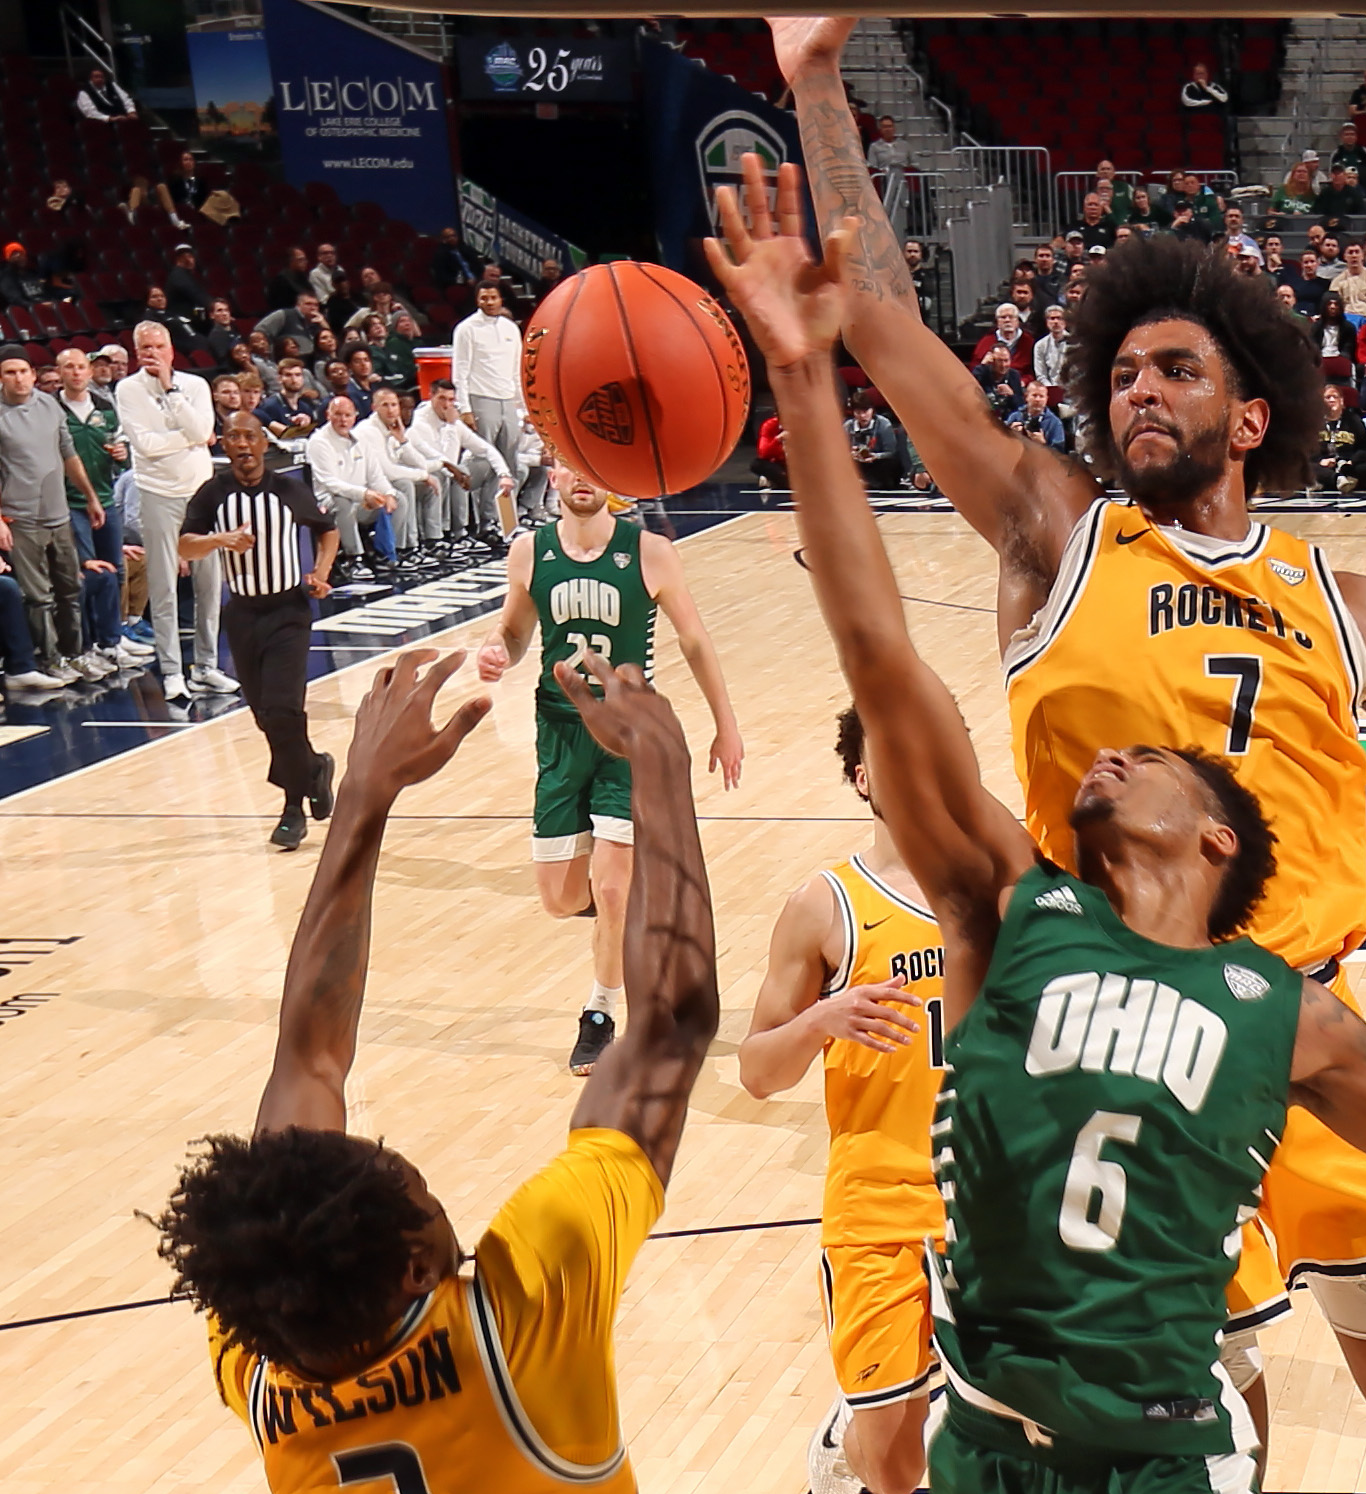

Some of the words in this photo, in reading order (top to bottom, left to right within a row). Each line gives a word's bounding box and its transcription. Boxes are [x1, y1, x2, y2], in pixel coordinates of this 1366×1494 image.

[522, 47, 571, 92] 25
[306, 128, 317, 137] OF
[319, 128, 377, 137] OSTEOPATHIC
[379, 128, 421, 137] MEDICINE
[320, 118, 343, 127] LAKE
[344, 118, 362, 127] ERIE
[364, 118, 402, 127] COLLEGE
[322, 158, 414, 169] www.LECOM.edu
[551, 578, 620, 627] OHIO
[1204, 653, 1264, 757] 7
[1024, 970, 1230, 1115] OHIO
[1058, 1109, 1142, 1253] 6
[261, 1326, 462, 1445] WILSON
